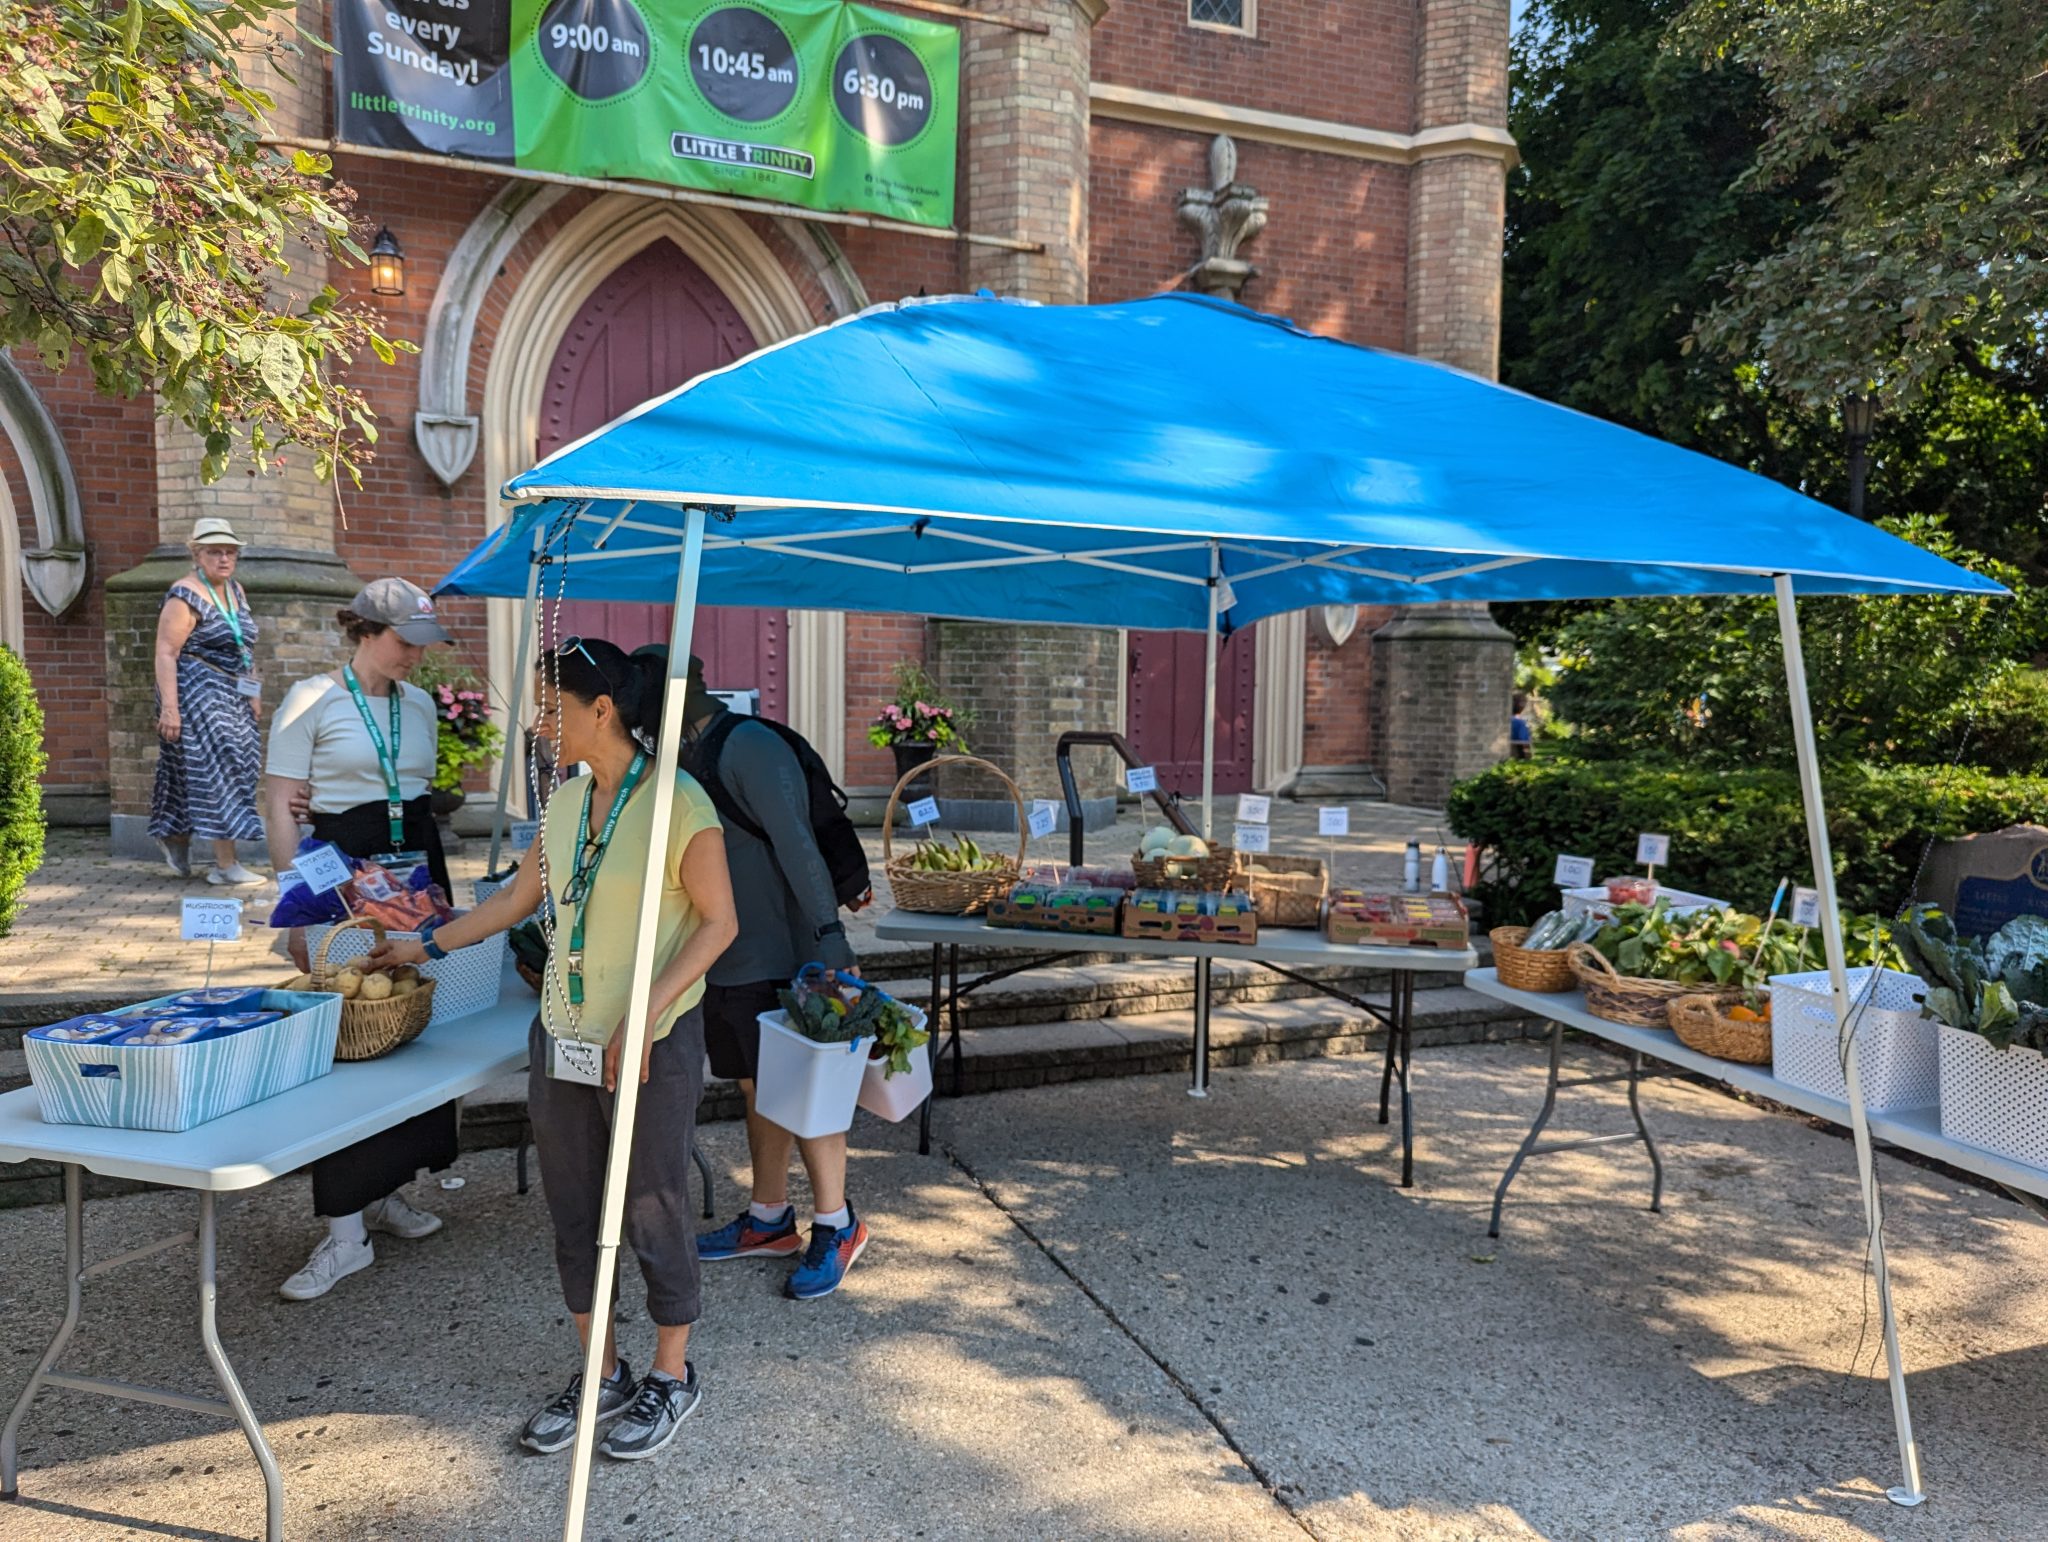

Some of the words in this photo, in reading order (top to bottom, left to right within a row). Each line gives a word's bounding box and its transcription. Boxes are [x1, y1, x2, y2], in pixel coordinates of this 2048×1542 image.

[385, 11, 461, 50] every
[551, 23, 609, 52] 9:00
[612, 37, 640, 58] am
[367, 31, 480, 86] Sunday!
[698, 44, 765, 80] 10:45
[767, 67, 793, 84] am
[843, 68, 896, 103] 6:30
[897, 91, 924, 110] pm
[351, 91, 496, 135] littletrinity.org
[681, 137, 737, 160] LITTLE
[713, 166, 747, 178] SINCE
[611, 787, 630, 817] Church
[185, 902, 237, 911] MUSHROOMS
[198, 913, 233, 925] 2.00
[193, 932, 229, 940] ONTARIO
